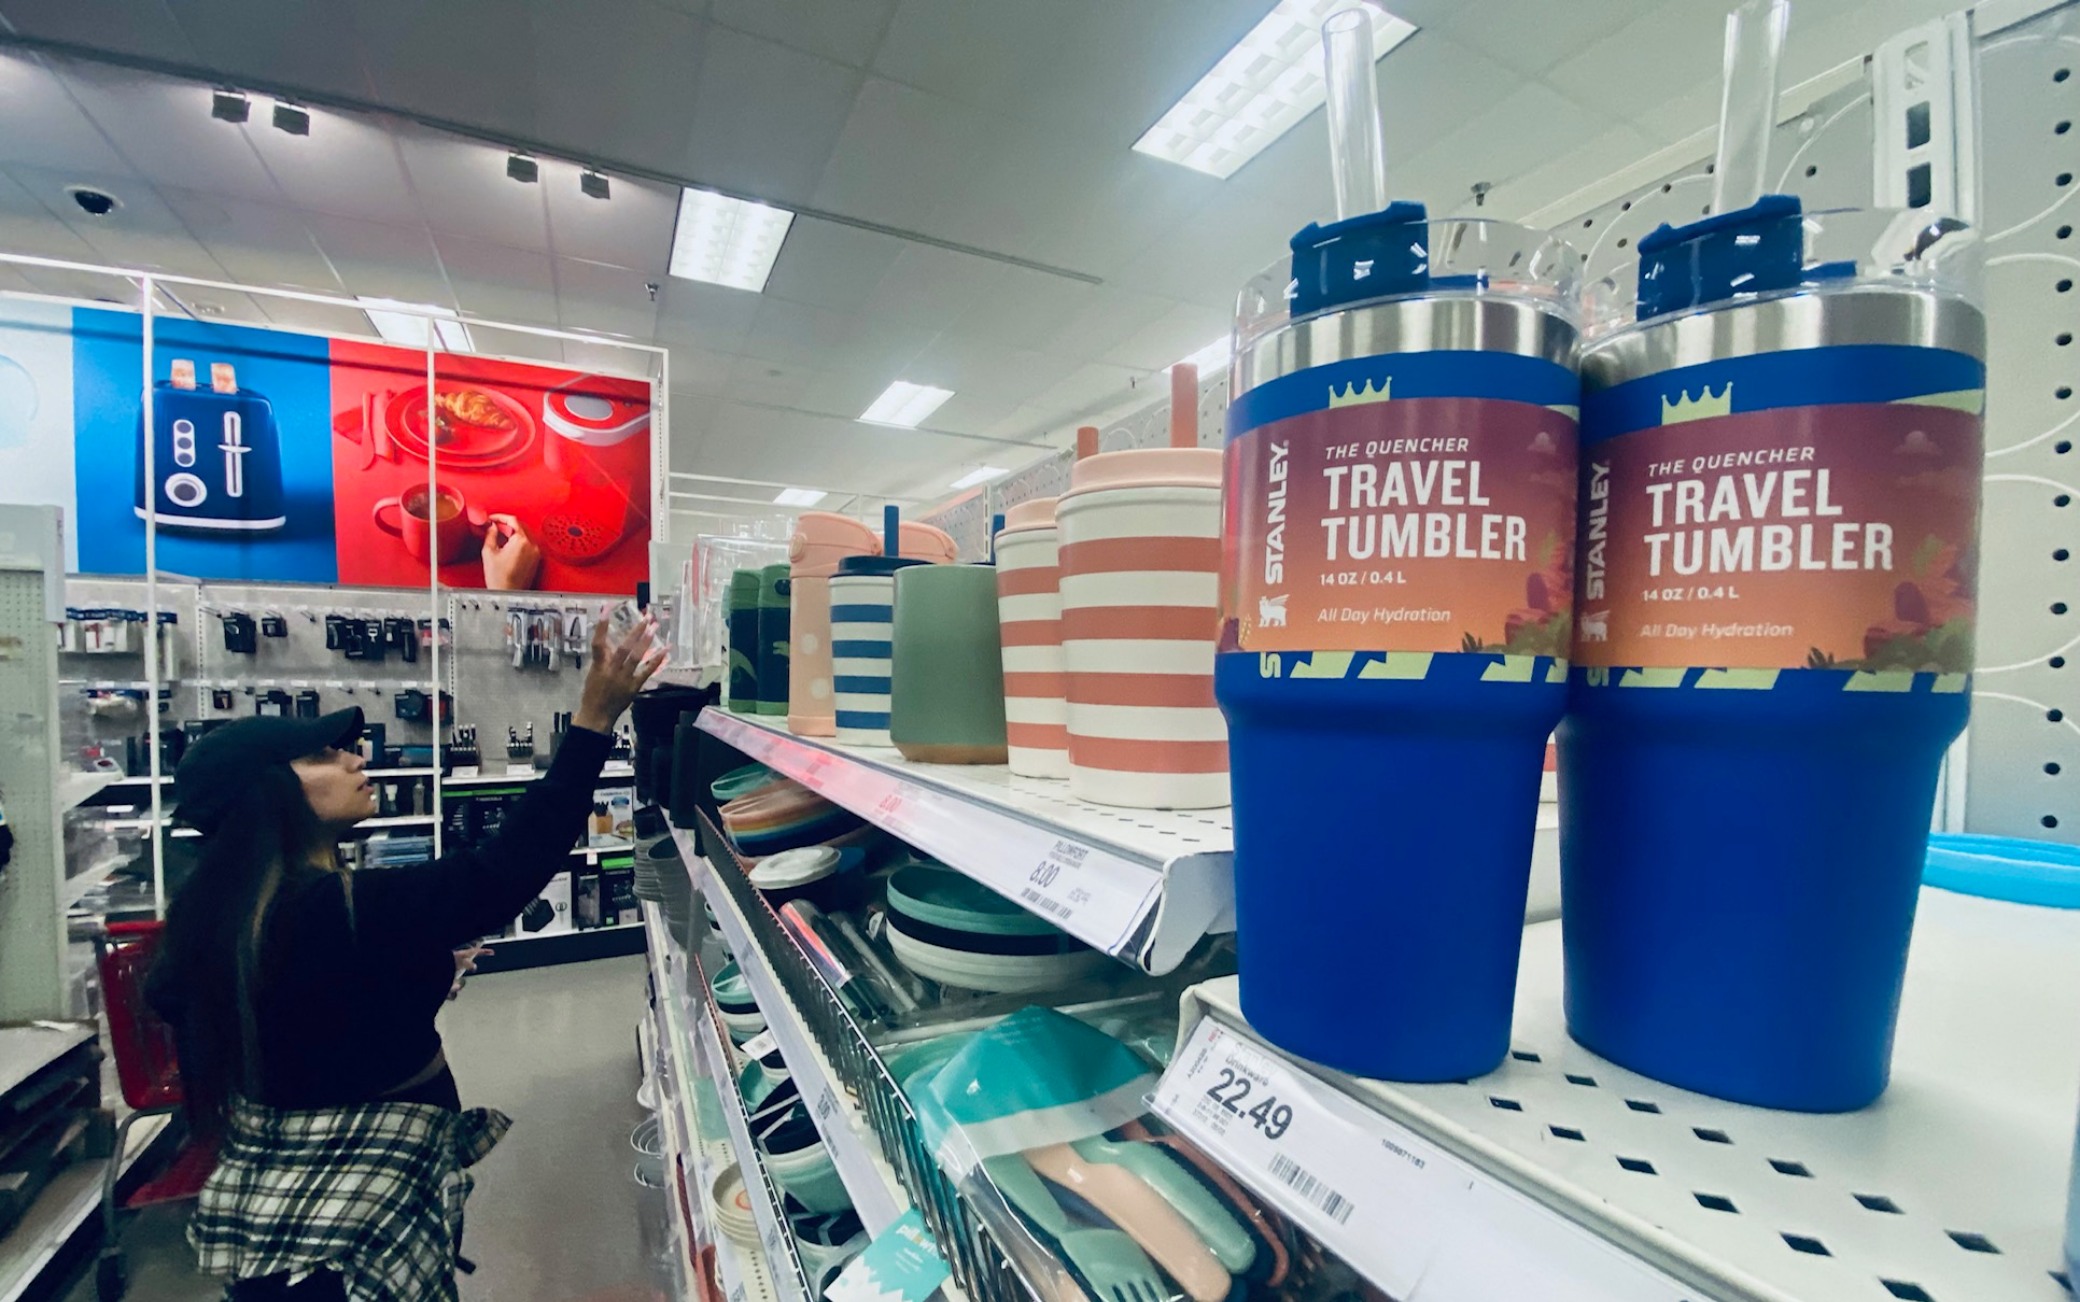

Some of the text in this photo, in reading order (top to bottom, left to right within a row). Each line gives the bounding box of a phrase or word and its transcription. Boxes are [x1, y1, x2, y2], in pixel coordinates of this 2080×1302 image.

[1325, 437, 1470, 460] THE QUENCHER
[1648, 446, 1816, 477] THE QUENCHER
[1322, 460, 1490, 511] TRAVEL
[1645, 468, 1843, 528] TRAVEL
[1264, 441, 1290, 585] STANLEY
[1586, 461, 1611, 600] STANLEY
[1320, 513, 1527, 562] TUMBLER
[1643, 522, 1894, 577] TUMBLER
[1320, 571, 1407, 586] 14 OZ / 0.4 L
[1642, 588, 1659, 602] 14
[1662, 587, 1684, 601] OZ
[1697, 586, 1725, 600] 0.4
[1728, 585, 1740, 599] L
[1317, 608, 1451, 626] All Day Hydration
[1640, 622, 1794, 640] All Day Hydration
[1029, 860, 1061, 889] 8.00
[1206, 1067, 1293, 1140] 22.49
